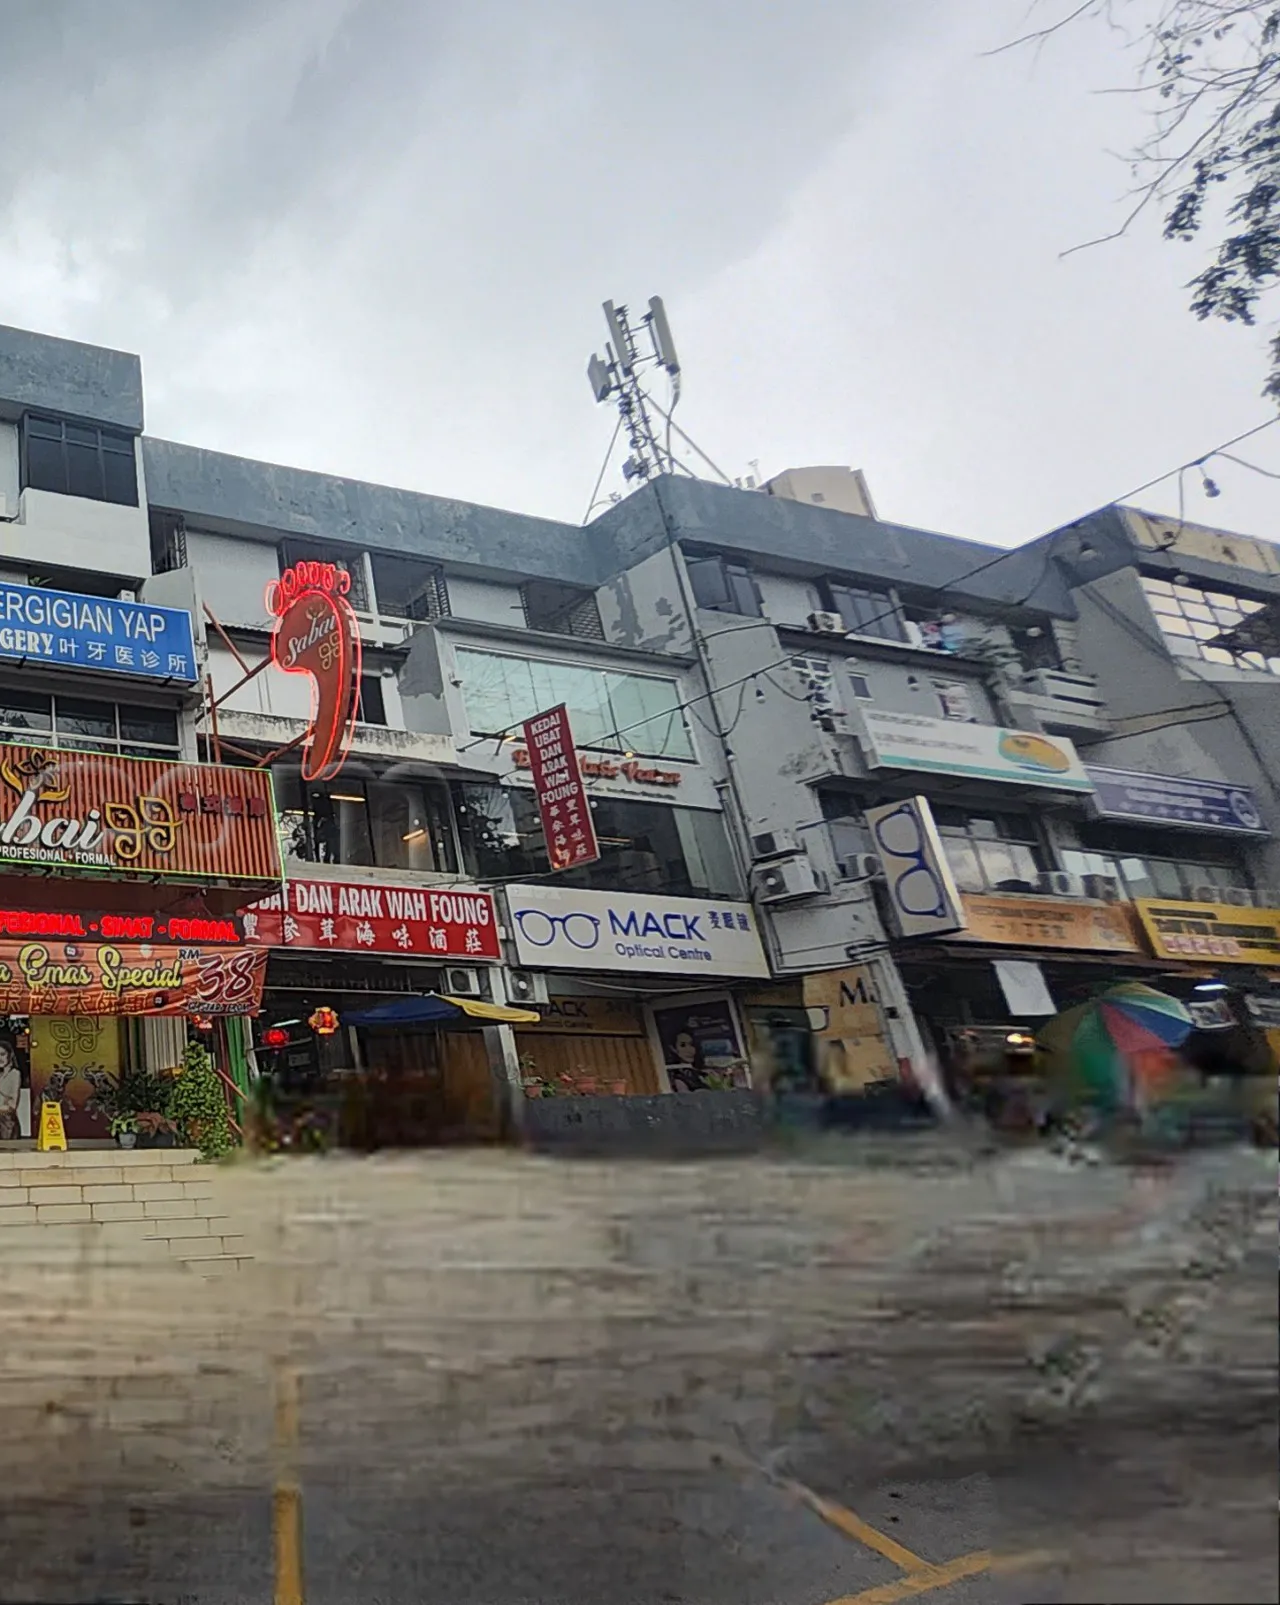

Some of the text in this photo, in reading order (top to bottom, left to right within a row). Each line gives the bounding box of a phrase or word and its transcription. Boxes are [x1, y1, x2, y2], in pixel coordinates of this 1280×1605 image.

[118, 608, 165, 642] YAP
[282, 612, 336, 668] Sabai
[531, 712, 560, 735] KEDAI
[534, 727, 561, 748] UBAT
[540, 742, 562, 761] DAN
[540, 755, 568, 776] ARAK
[544, 769, 570, 789] WAH
[541, 782, 578, 806] FOUNG
[75, 851, 117, 866] FORMAL
[295, 883, 333, 916] DAN
[338, 887, 384, 919] ARAK
[385, 890, 426, 922] WAH
[429, 893, 490, 926] FOUNG
[607, 908, 707, 941] MACK
[615, 943, 712, 961] Optical Centre
[18, 943, 93, 986] Emas
[96, 944, 183, 997] Special
[178, 948, 259, 1001] RM 38
